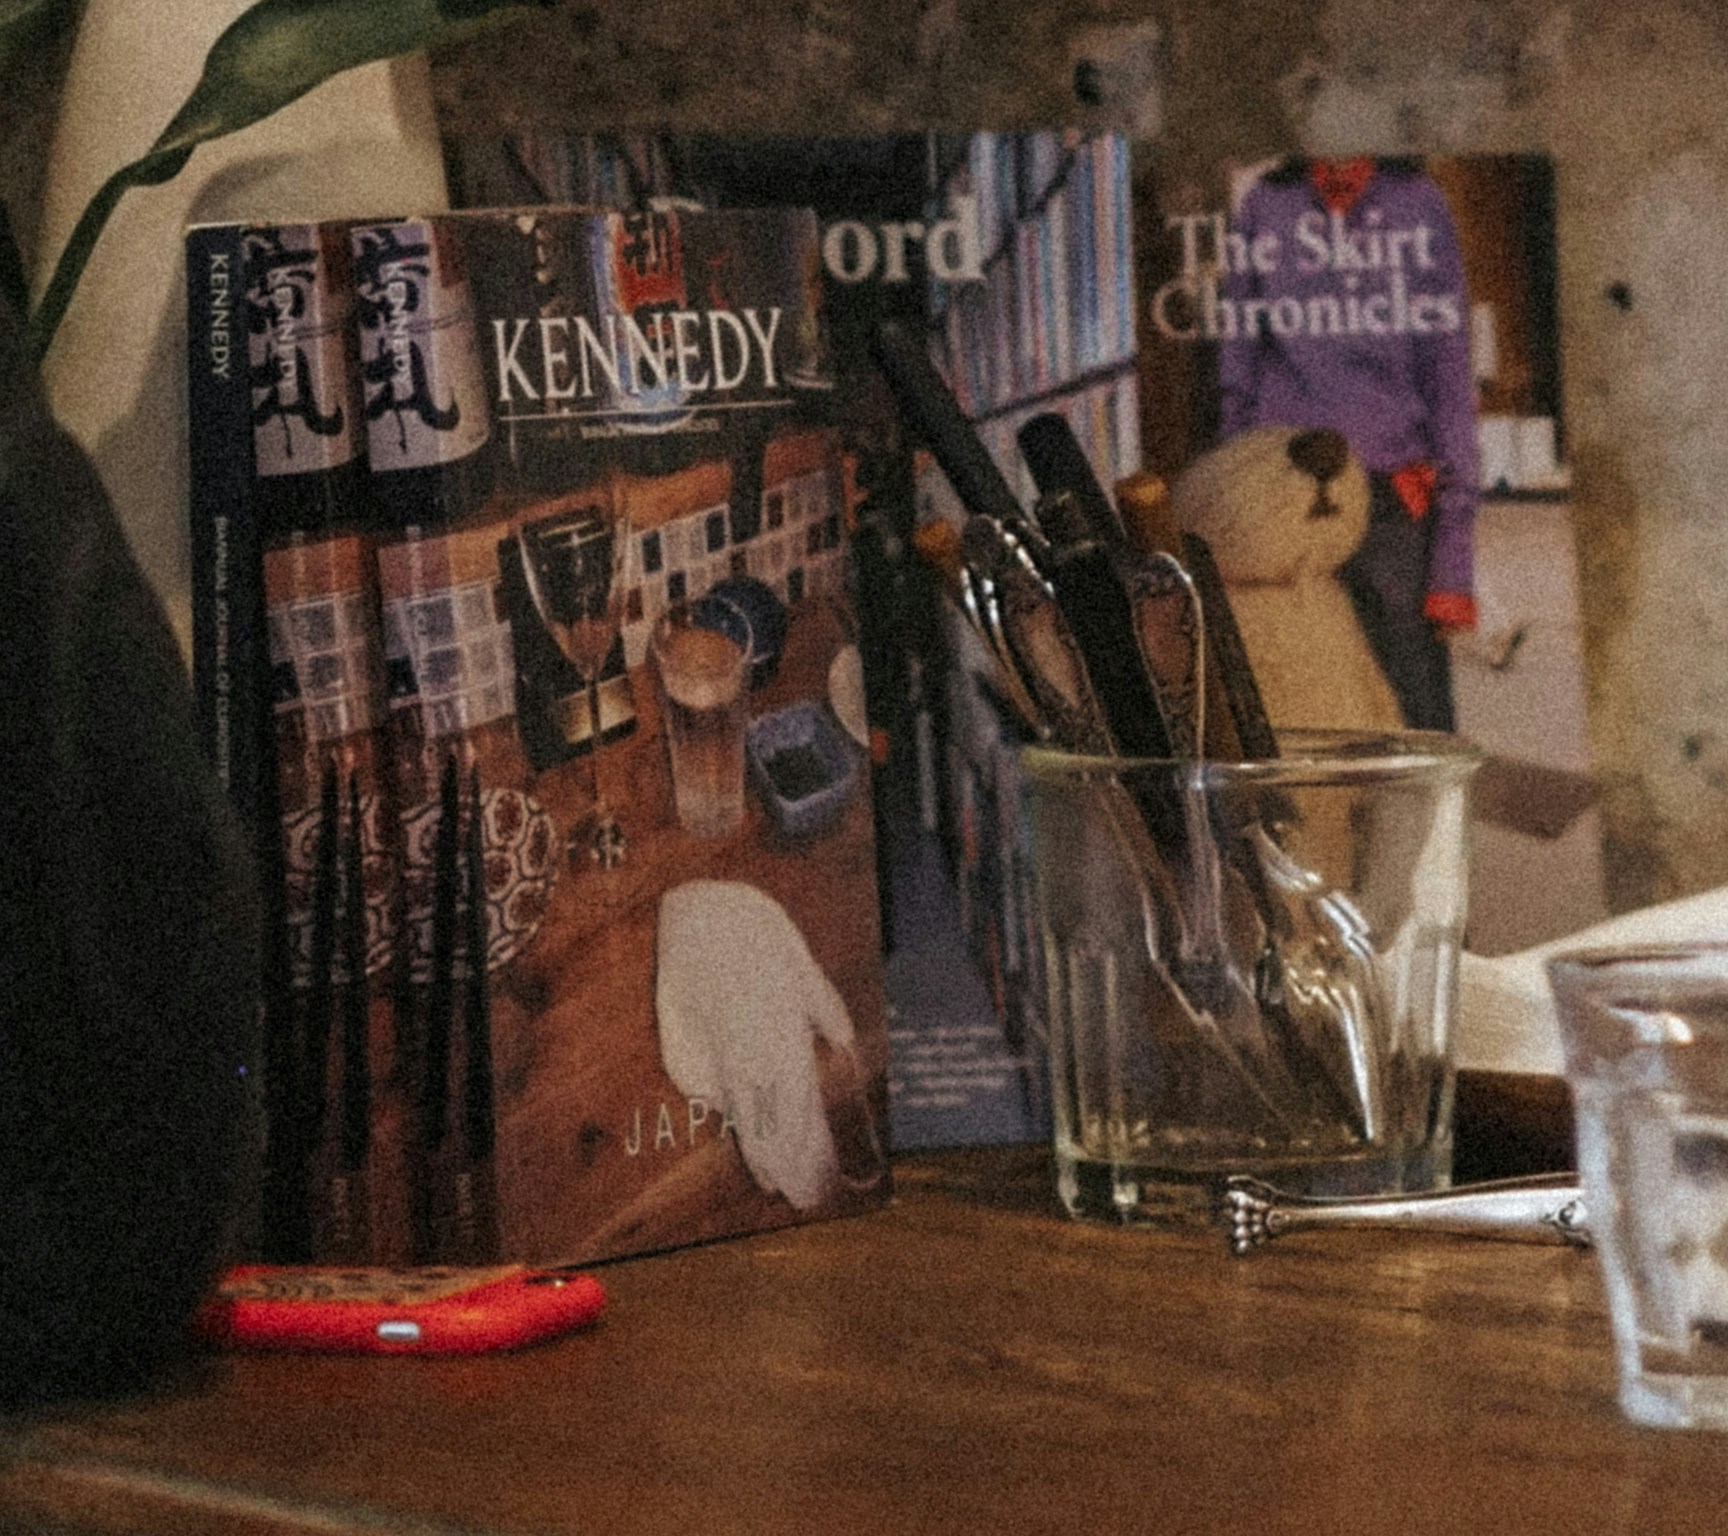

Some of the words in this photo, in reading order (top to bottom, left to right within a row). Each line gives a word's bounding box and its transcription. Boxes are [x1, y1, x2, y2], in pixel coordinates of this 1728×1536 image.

[823, 194, 986, 283] ord
[1164, 211, 1282, 276] The
[1296, 208, 1434, 271] Skirt
[208, 252, 231, 380] KENNEDY
[384, 261, 410, 384] KENNEDY
[1152, 270, 1459, 339] Chronicles
[492, 308, 782, 403] KENNEDY
[624, 1081, 779, 1157] JAPAN
